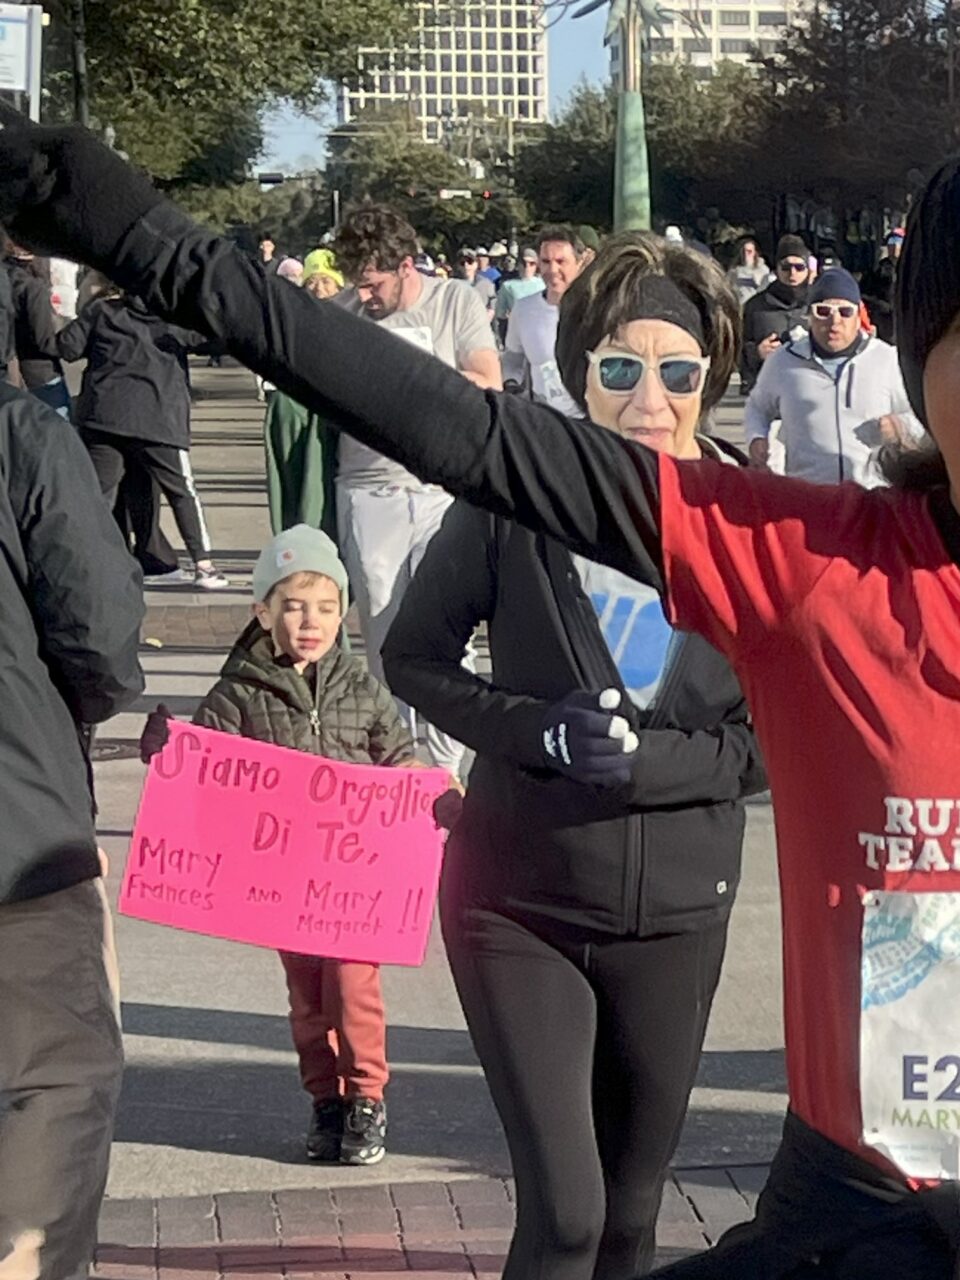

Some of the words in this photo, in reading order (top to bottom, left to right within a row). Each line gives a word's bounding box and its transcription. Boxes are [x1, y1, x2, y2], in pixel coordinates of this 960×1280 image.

[309, 764, 447, 828] Orgoglio
[253, 812, 292, 855] Di
[139, 836, 222, 887] Mary
[127, 874, 215, 911] Frances
[247, 887, 282, 904] AND
[304, 879, 382, 919] Mary
[296, 914, 382, 944] Margaret
